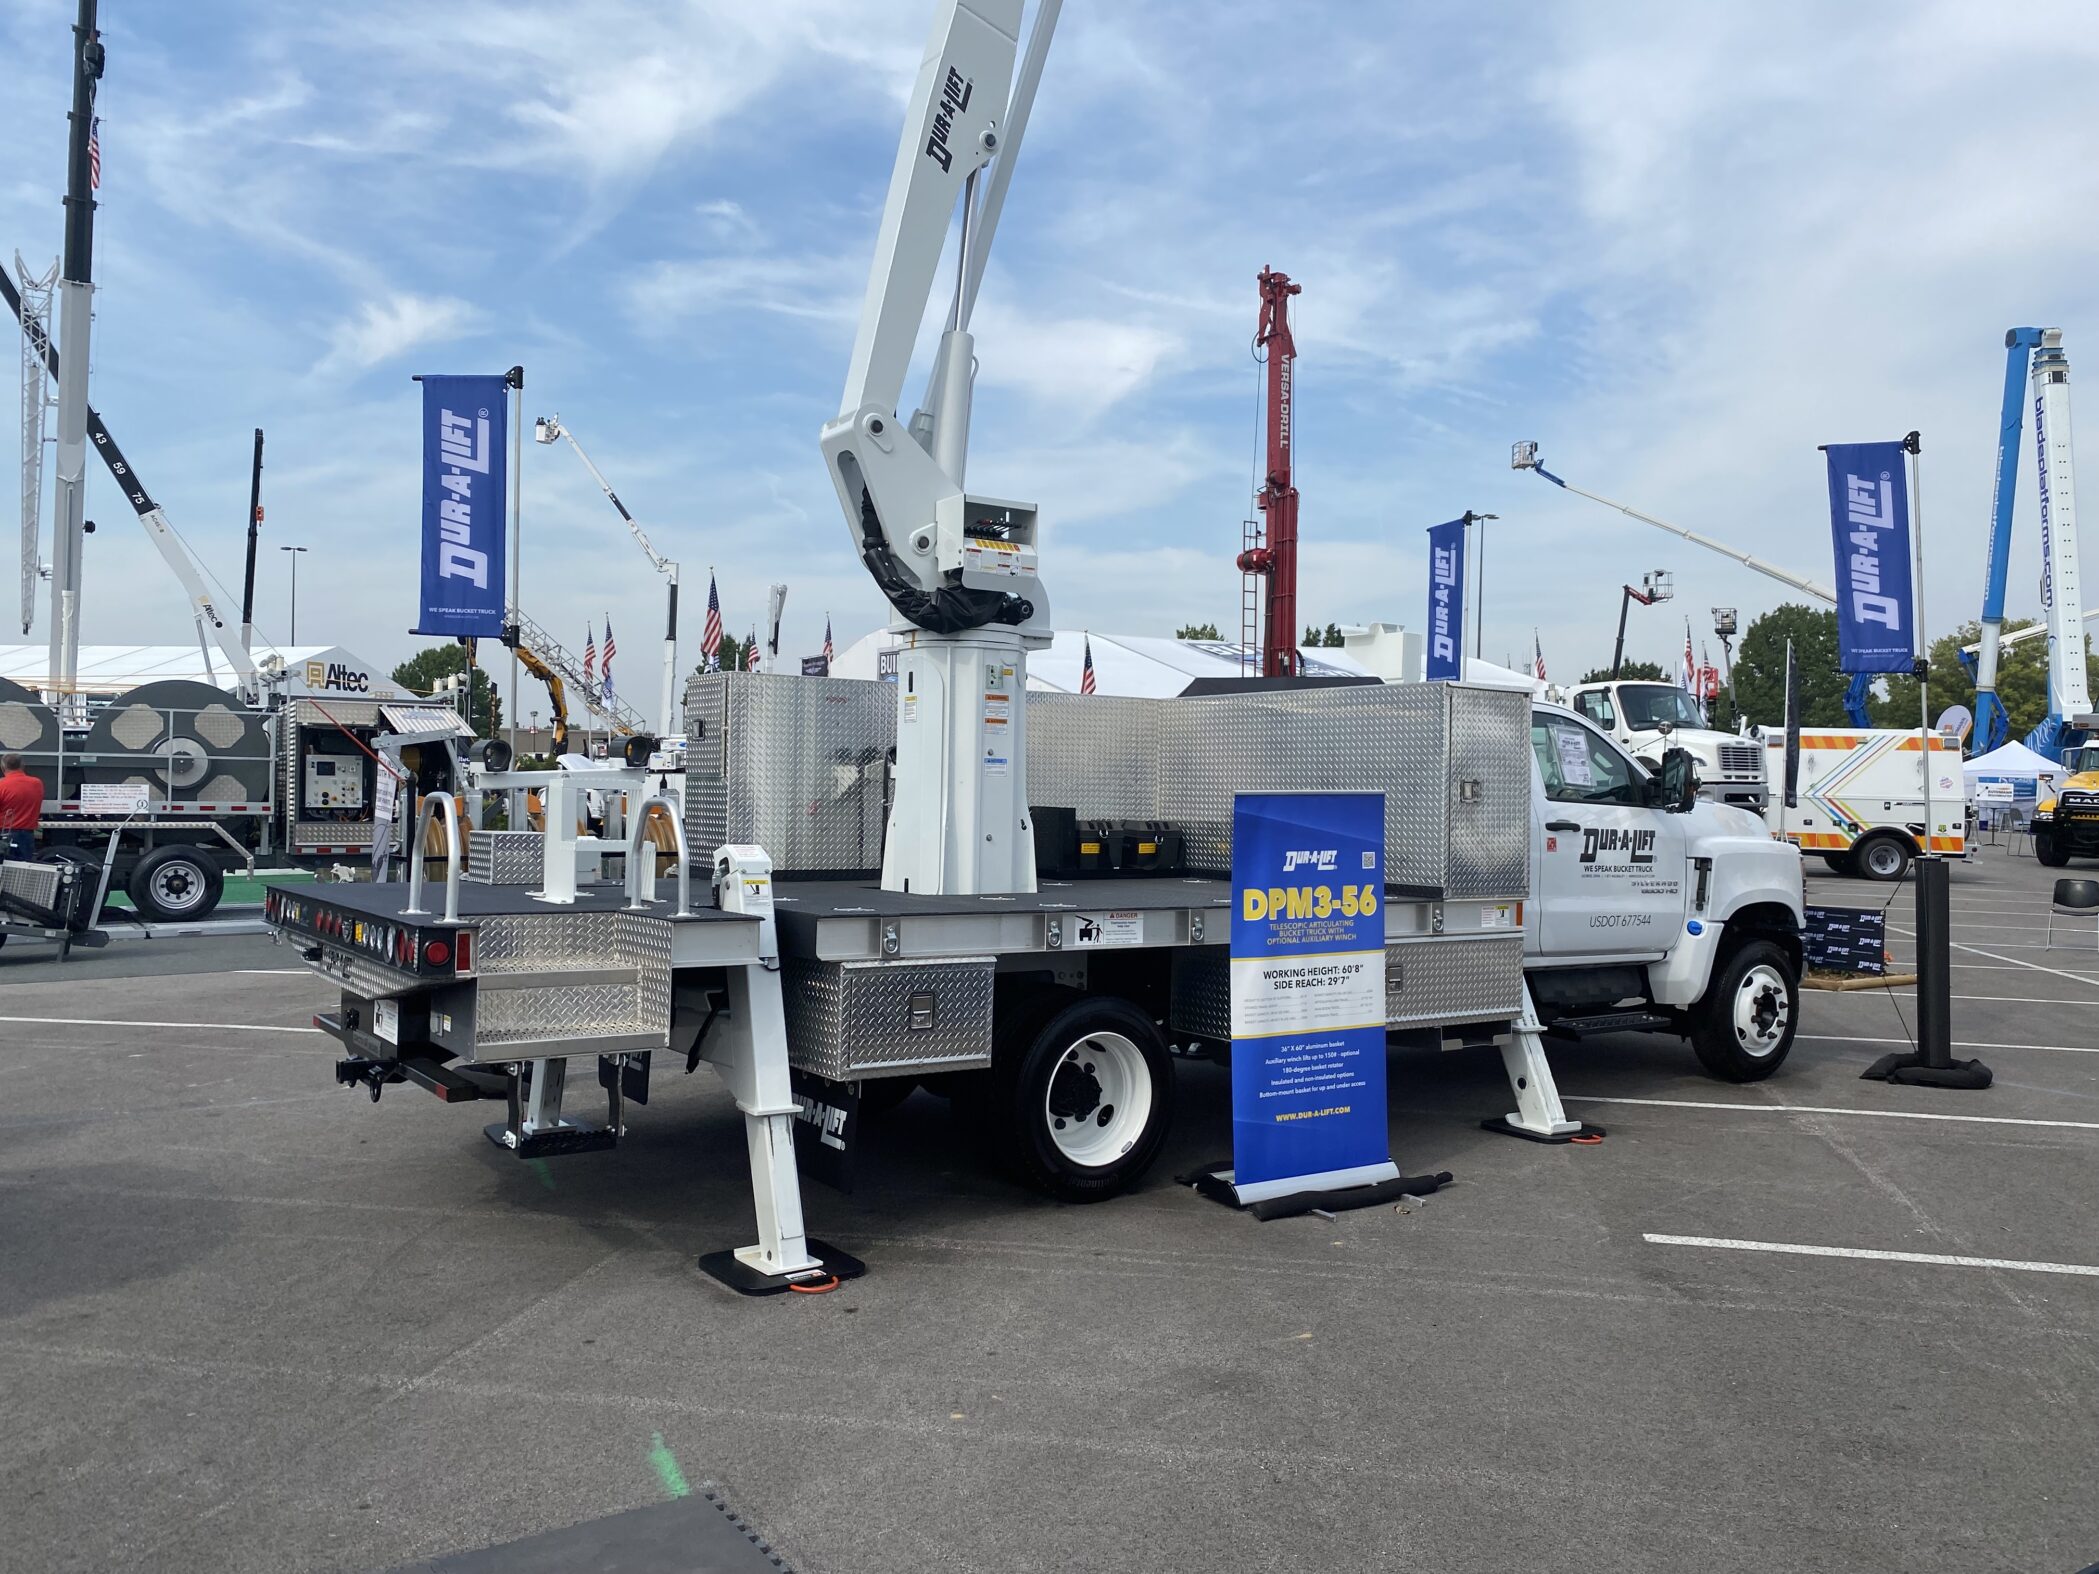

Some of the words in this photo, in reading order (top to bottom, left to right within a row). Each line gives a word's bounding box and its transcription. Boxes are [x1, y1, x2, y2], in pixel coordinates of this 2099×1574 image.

[1280, 354, 1290, 449] VERSA-DRILL
[95, 432, 107, 445] 43
[113, 461, 126, 475] 59
[131, 491, 145, 505] 75
[2035, 396, 2053, 608] bladeplatforms.com
[325, 663, 369, 692] Altec
[1584, 865, 1593, 873] WE
[1594, 865, 1613, 873] SPEAK
[1613, 865, 1635, 873] BUCKET
[1635, 865, 1653, 873] TRUCK
[1243, 884, 1377, 922] DPM3-56
[1269, 922, 1308, 931] TELESCOPIC
[1309, 920, 1354, 928] ARTICULATING
[1589, 915, 1621, 928] USDOT
[1621, 914, 1652, 927] 677544
[1279, 929, 1305, 937] BUCKET
[1267, 937, 1300, 946] OPTIONAL
[1301, 935, 1334, 943] AUXILIARY
[1263, 968, 1306, 979] WORKING
[1307, 966, 1340, 977] HEIGHT:
[1274, 980, 1293, 990] SIDE
[1295, 977, 1326, 988] REACH:
[1265, 1057, 1286, 1065] Auxiliary
[1287, 1055, 1302, 1063] winch
[1340, 1049, 1360, 1058] optional
[1282, 1066, 1311, 1074] 180-degree
[1271, 1078, 1294, 1086] Insulated
[1304, 1074, 1336, 1082] non-insulated
[1337, 1072, 1354, 1080] options
[1259, 1089, 1294, 1098] Bottom-mount
[1295, 1086, 1311, 1094] basket
[1276, 1106, 1351, 1122] WWW.DUR-A-LIFT.COM
